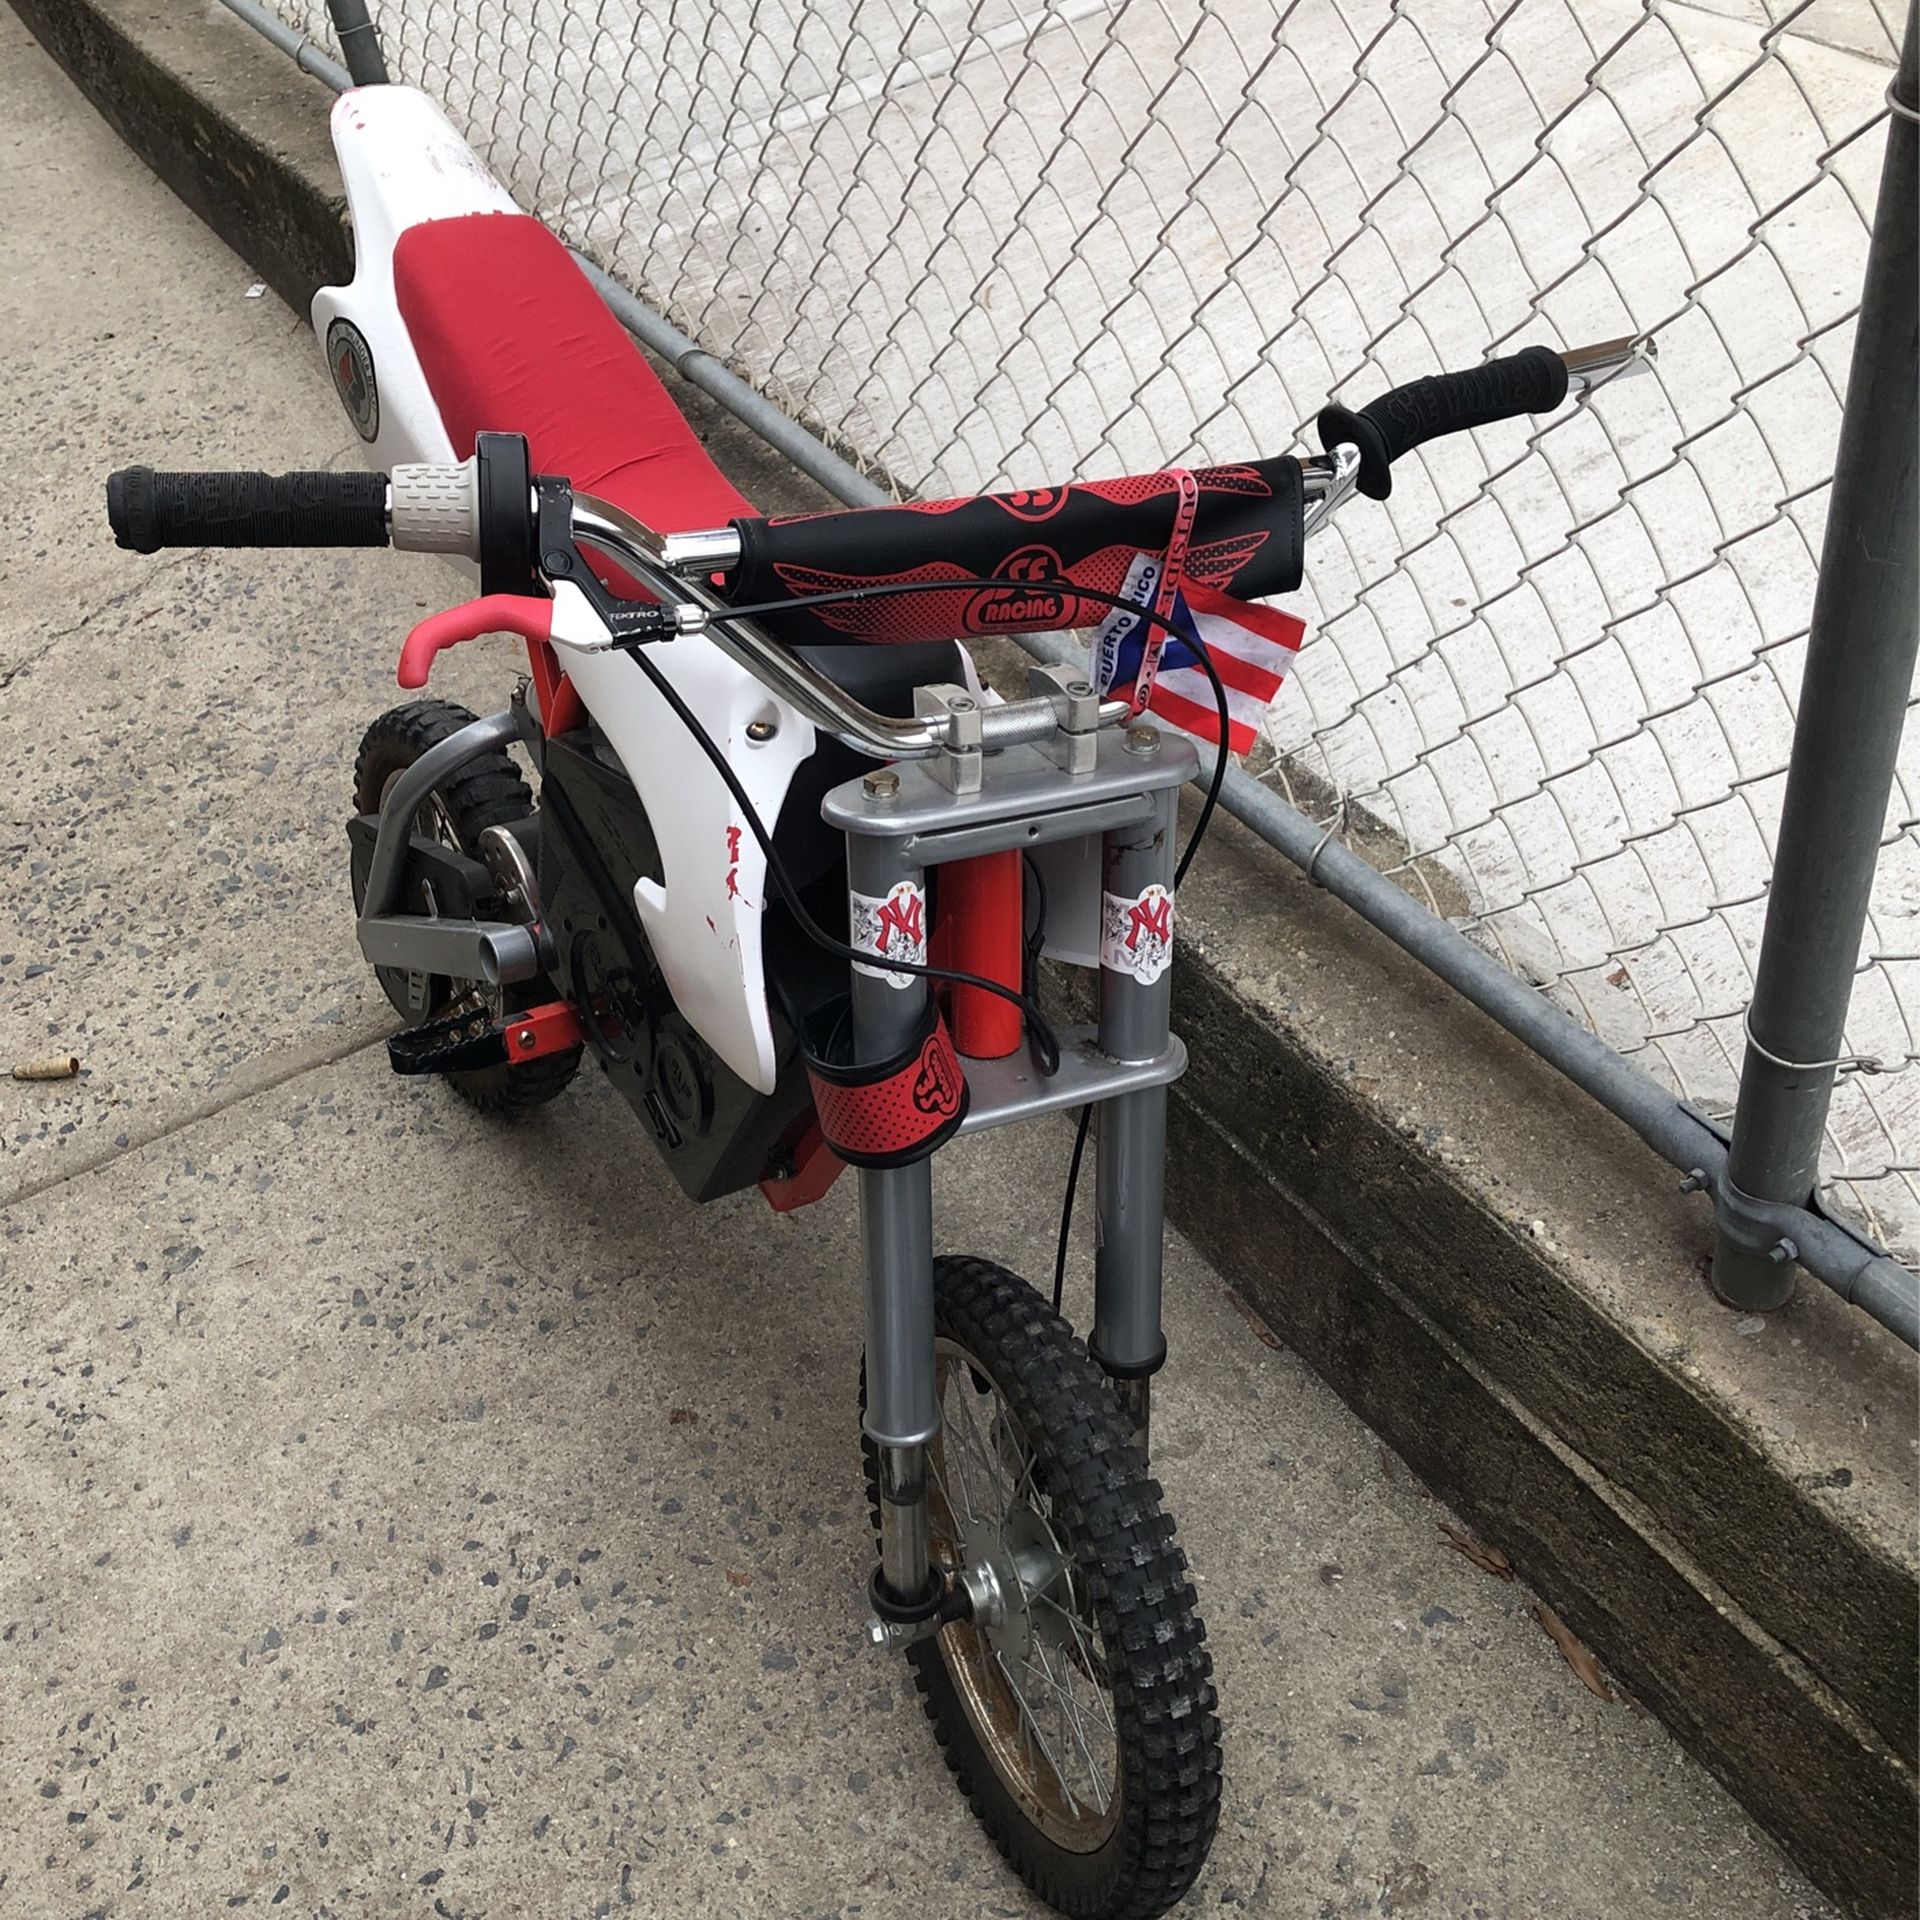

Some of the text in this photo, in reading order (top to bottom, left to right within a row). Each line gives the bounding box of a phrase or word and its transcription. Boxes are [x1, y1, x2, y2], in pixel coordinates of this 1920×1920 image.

[1162, 475, 1197, 604] OUTSIDE
[984, 597, 1057, 622] RACING
[1100, 566, 1156, 689] PUERTO RICO
[875, 894, 923, 953] NY
[1125, 896, 1171, 951] NY
